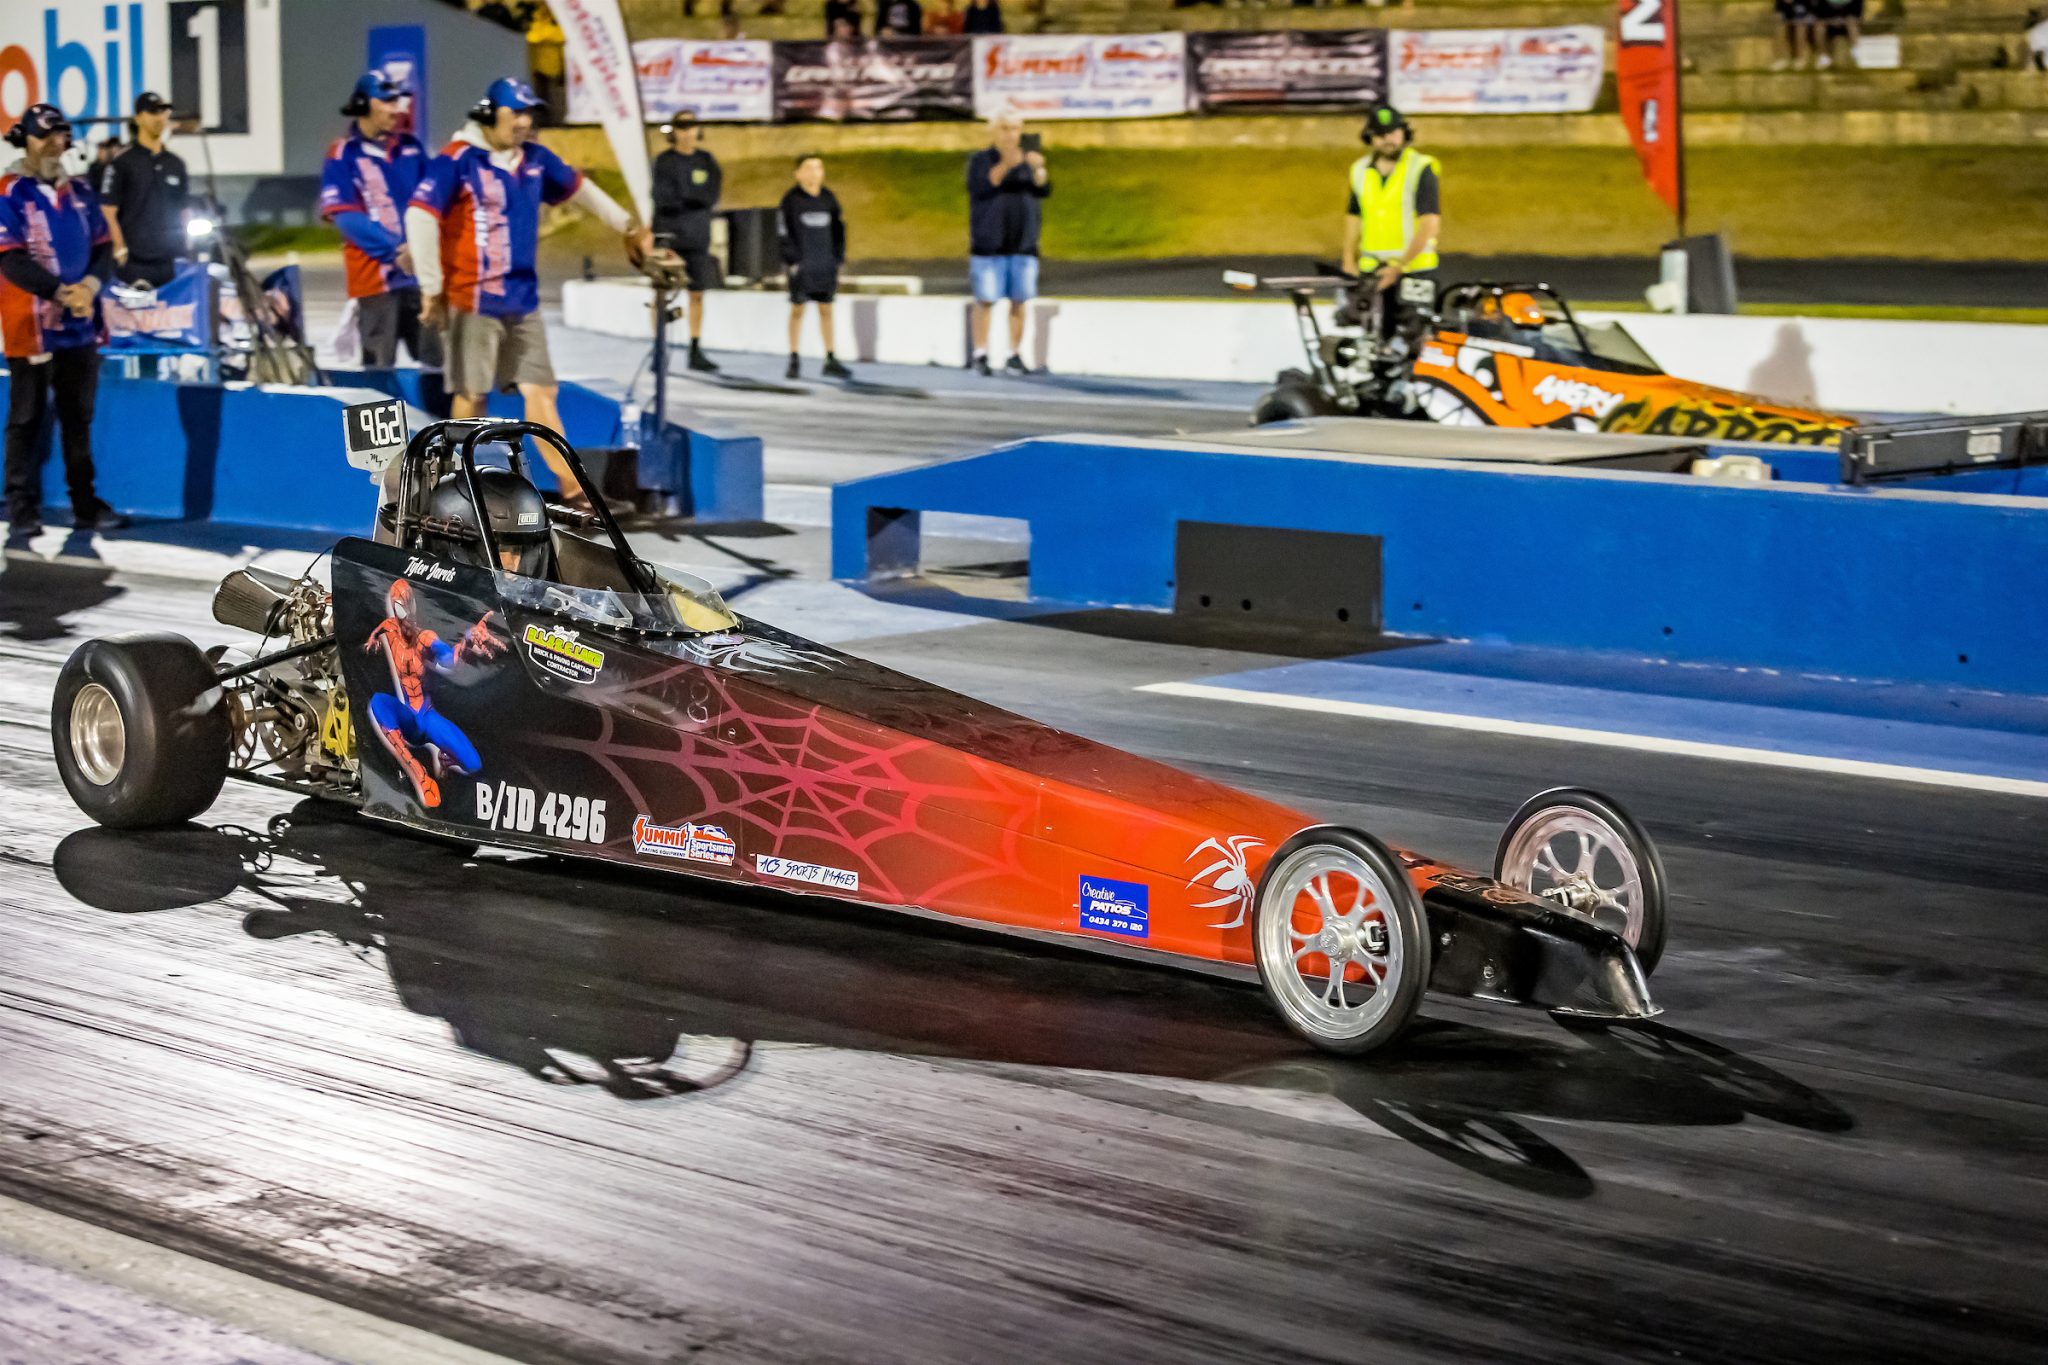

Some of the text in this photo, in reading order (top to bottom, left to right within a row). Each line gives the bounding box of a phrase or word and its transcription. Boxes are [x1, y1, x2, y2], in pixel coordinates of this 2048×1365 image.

[187, 5, 222, 128] 1
[1533, 375, 1624, 418] ANGRY
[360, 405, 402, 446] 9.62
[403, 556, 457, 583] Tyler Jarvis
[533, 647, 549, 659] BRICK
[553, 654, 571, 667] PAVING
[570, 660, 593, 676] CARTAGE
[546, 660, 579, 678] CONTRACTOR
[476, 780, 607, 844] B/JD 4296
[641, 847, 686, 858] RACING EQUIPMENT
[690, 848, 715, 861] Series
[691, 840, 733, 855] Sportsman
[784, 862, 821, 880] SPORTS
[822, 868, 857, 886] IMAGES
[1081, 881, 1116, 902] Creative
[1090, 900, 1132, 916] PATIOS
[1112, 919, 1128, 929] 370
